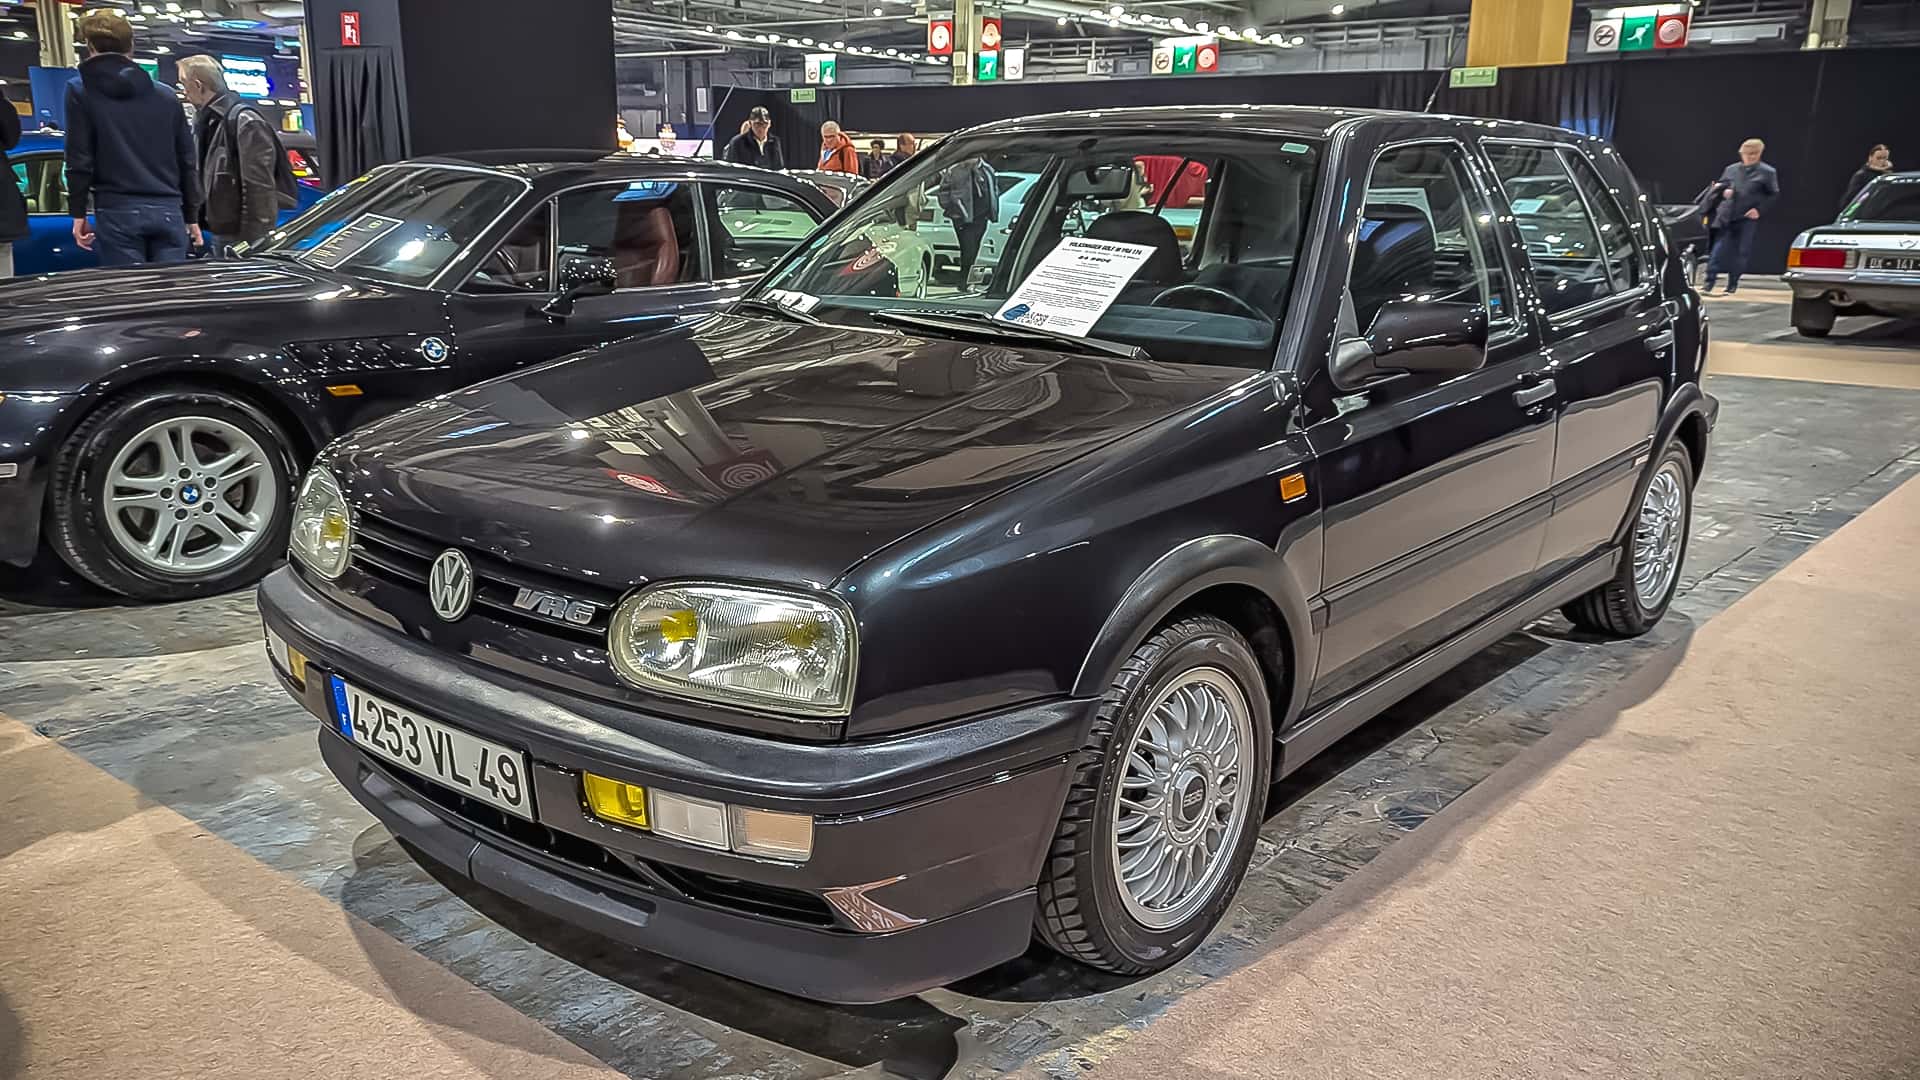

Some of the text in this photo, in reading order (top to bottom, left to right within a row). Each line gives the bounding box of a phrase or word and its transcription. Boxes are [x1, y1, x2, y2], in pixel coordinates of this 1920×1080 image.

[512, 587, 596, 625] VR6
[353, 694, 522, 807] 4253 VL 49
